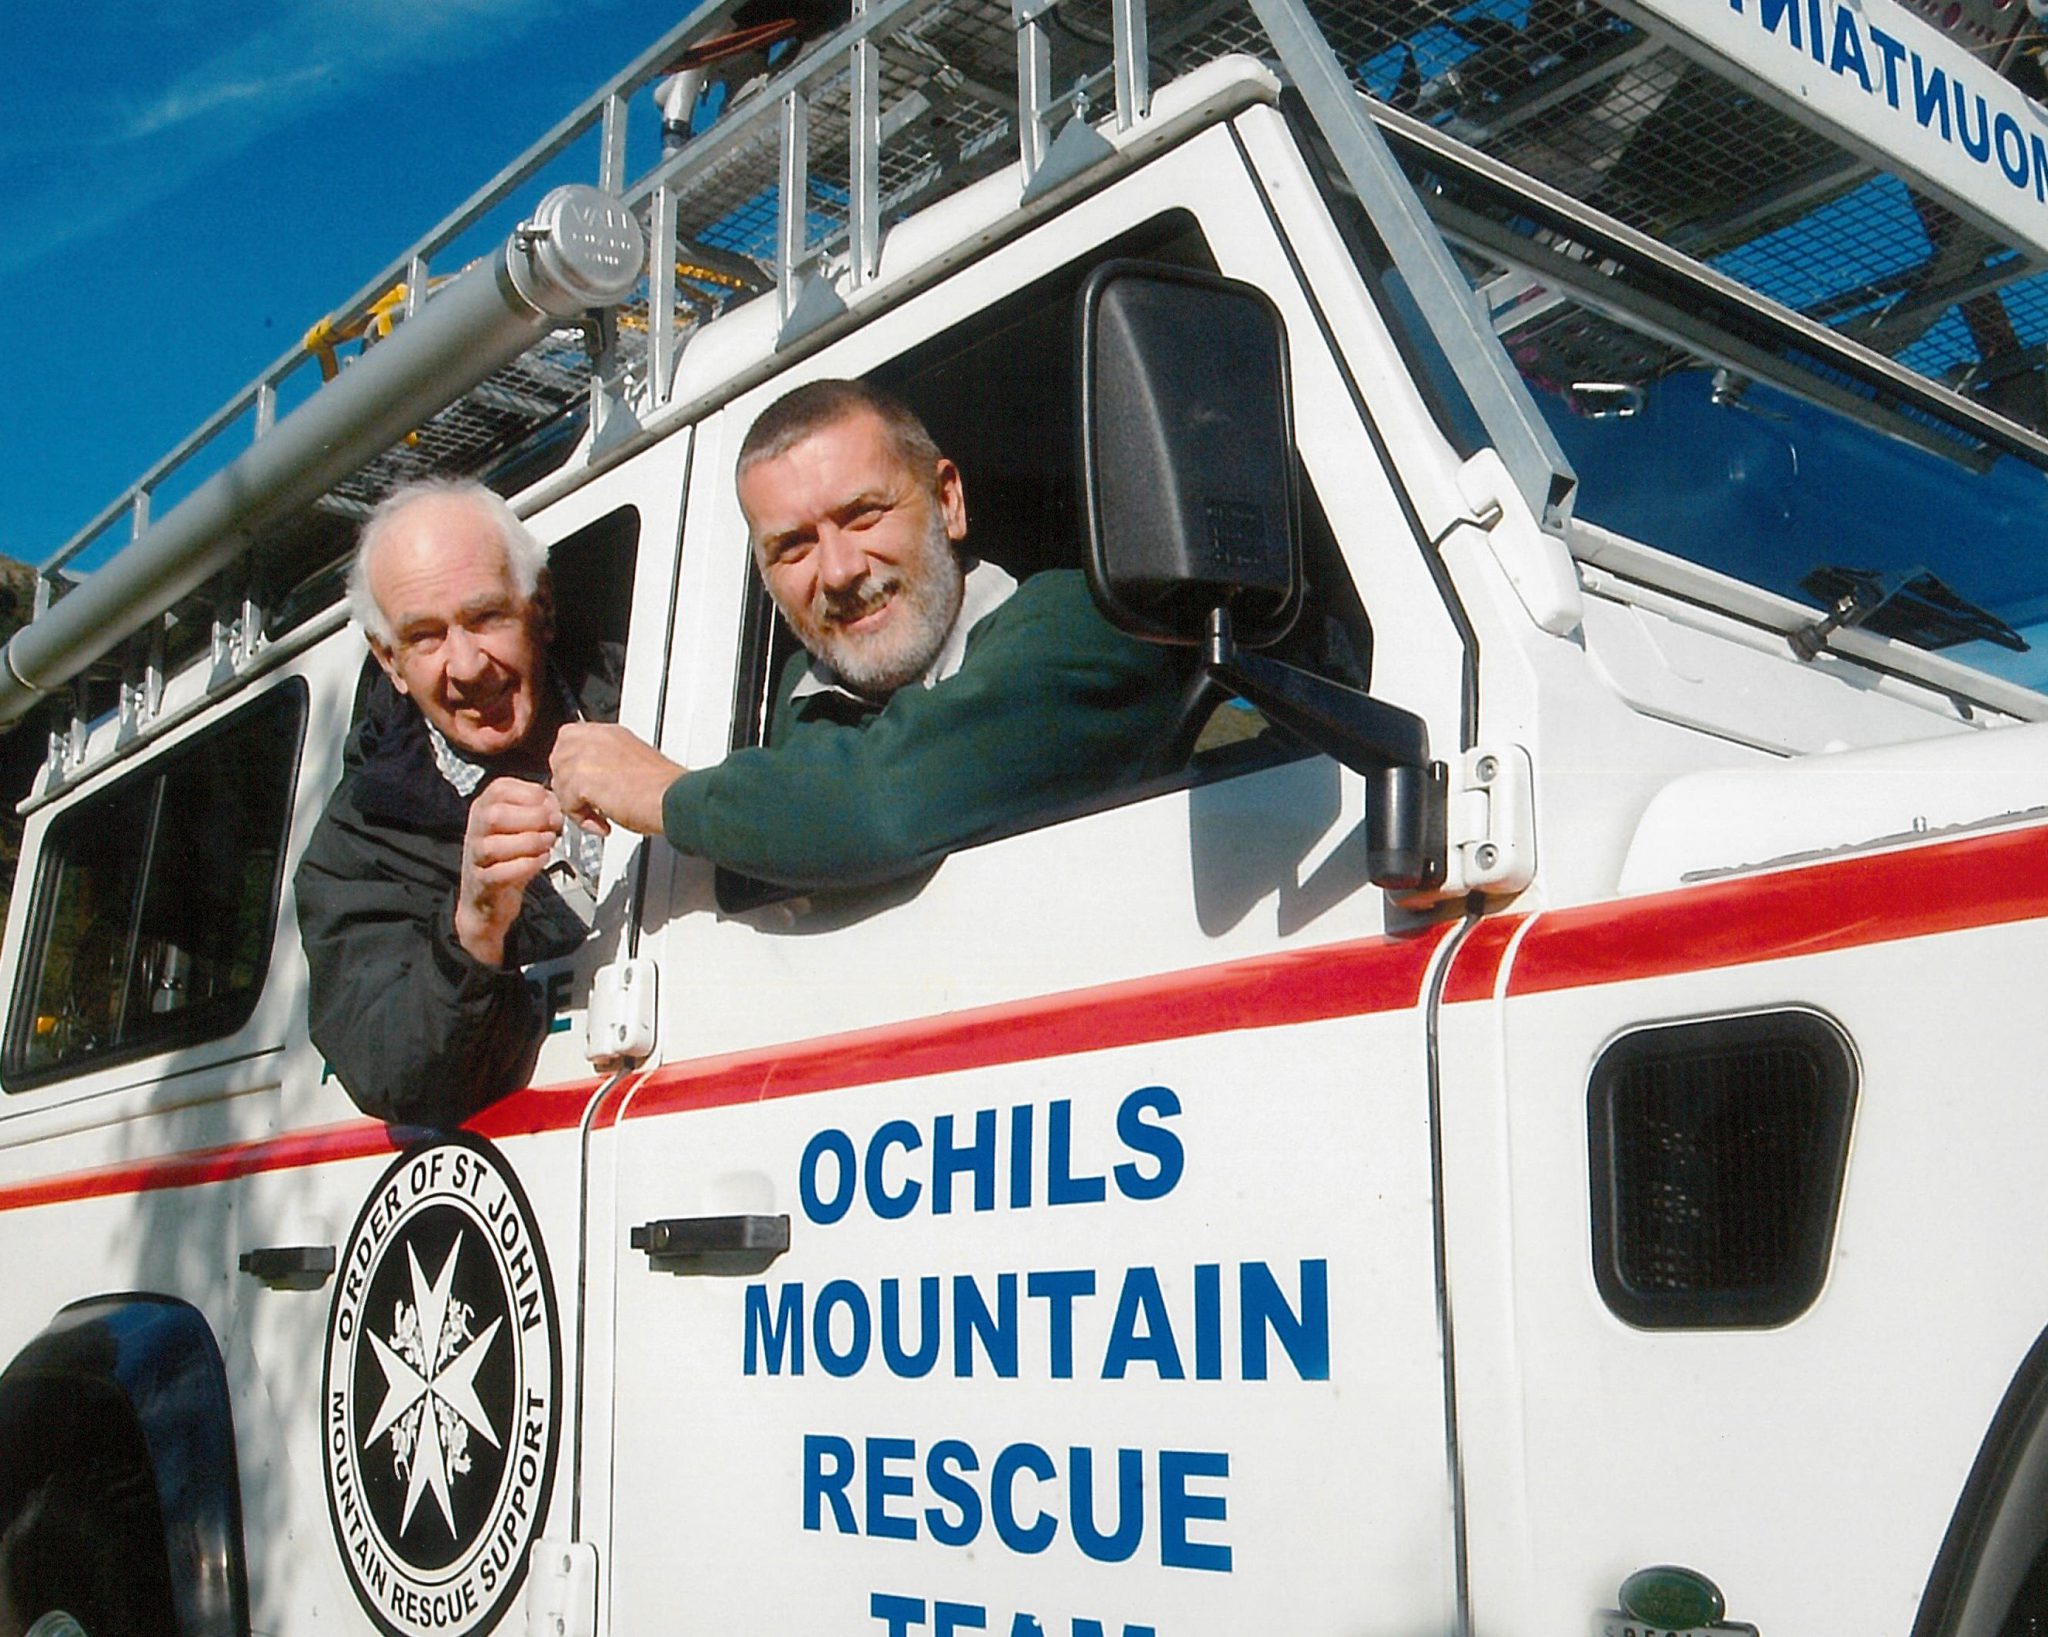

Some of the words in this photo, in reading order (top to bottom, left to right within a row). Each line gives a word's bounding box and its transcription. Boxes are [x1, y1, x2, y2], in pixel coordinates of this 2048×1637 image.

[799, 1086, 1184, 1225] OCHILS
[338, 1184, 402, 1342] ORDER
[410, 1153, 444, 1196] OF
[452, 1153, 488, 1197] ST
[488, 1192, 541, 1332] JOHN
[743, 1258, 1330, 1381] MOUNTAIN
[331, 1390, 387, 1597] MOUNTAIN
[390, 1578, 479, 1628] RESCUE
[480, 1388, 544, 1592] SUPPORT
[803, 1434, 1233, 1573] RESCUE
